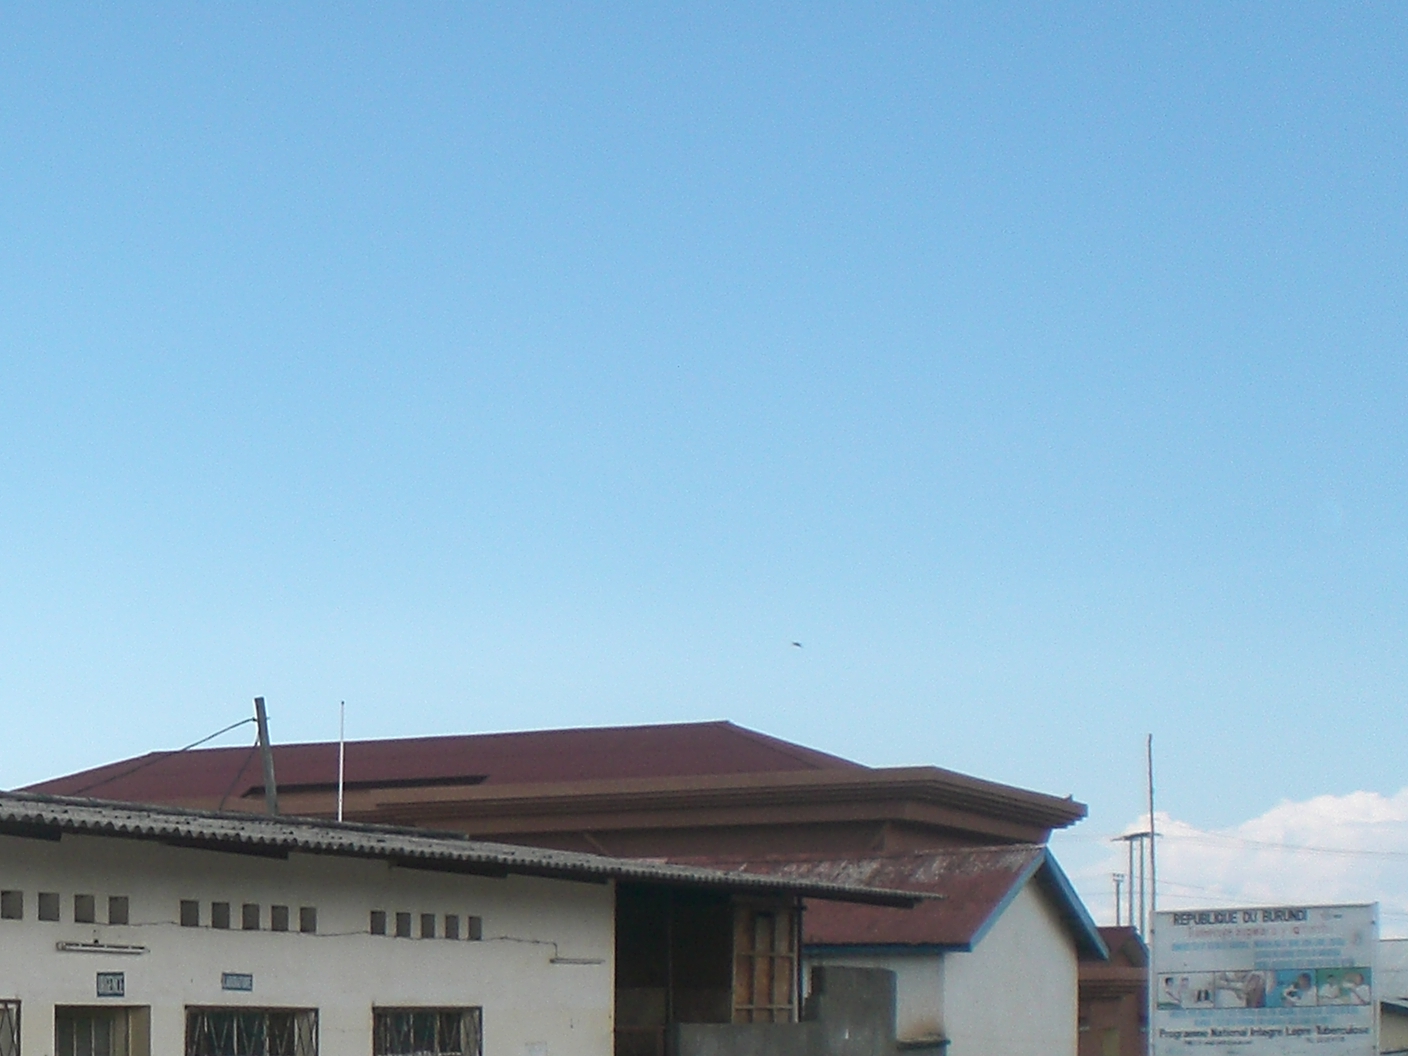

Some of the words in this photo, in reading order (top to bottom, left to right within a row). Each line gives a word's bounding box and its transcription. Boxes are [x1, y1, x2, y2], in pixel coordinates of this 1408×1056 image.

[1243, 911, 1257, 923] DU
[1262, 908, 1307, 922] BURUNDI
[1159, 1028, 1208, 1040] Programme
[1211, 1026, 1247, 1037] National
